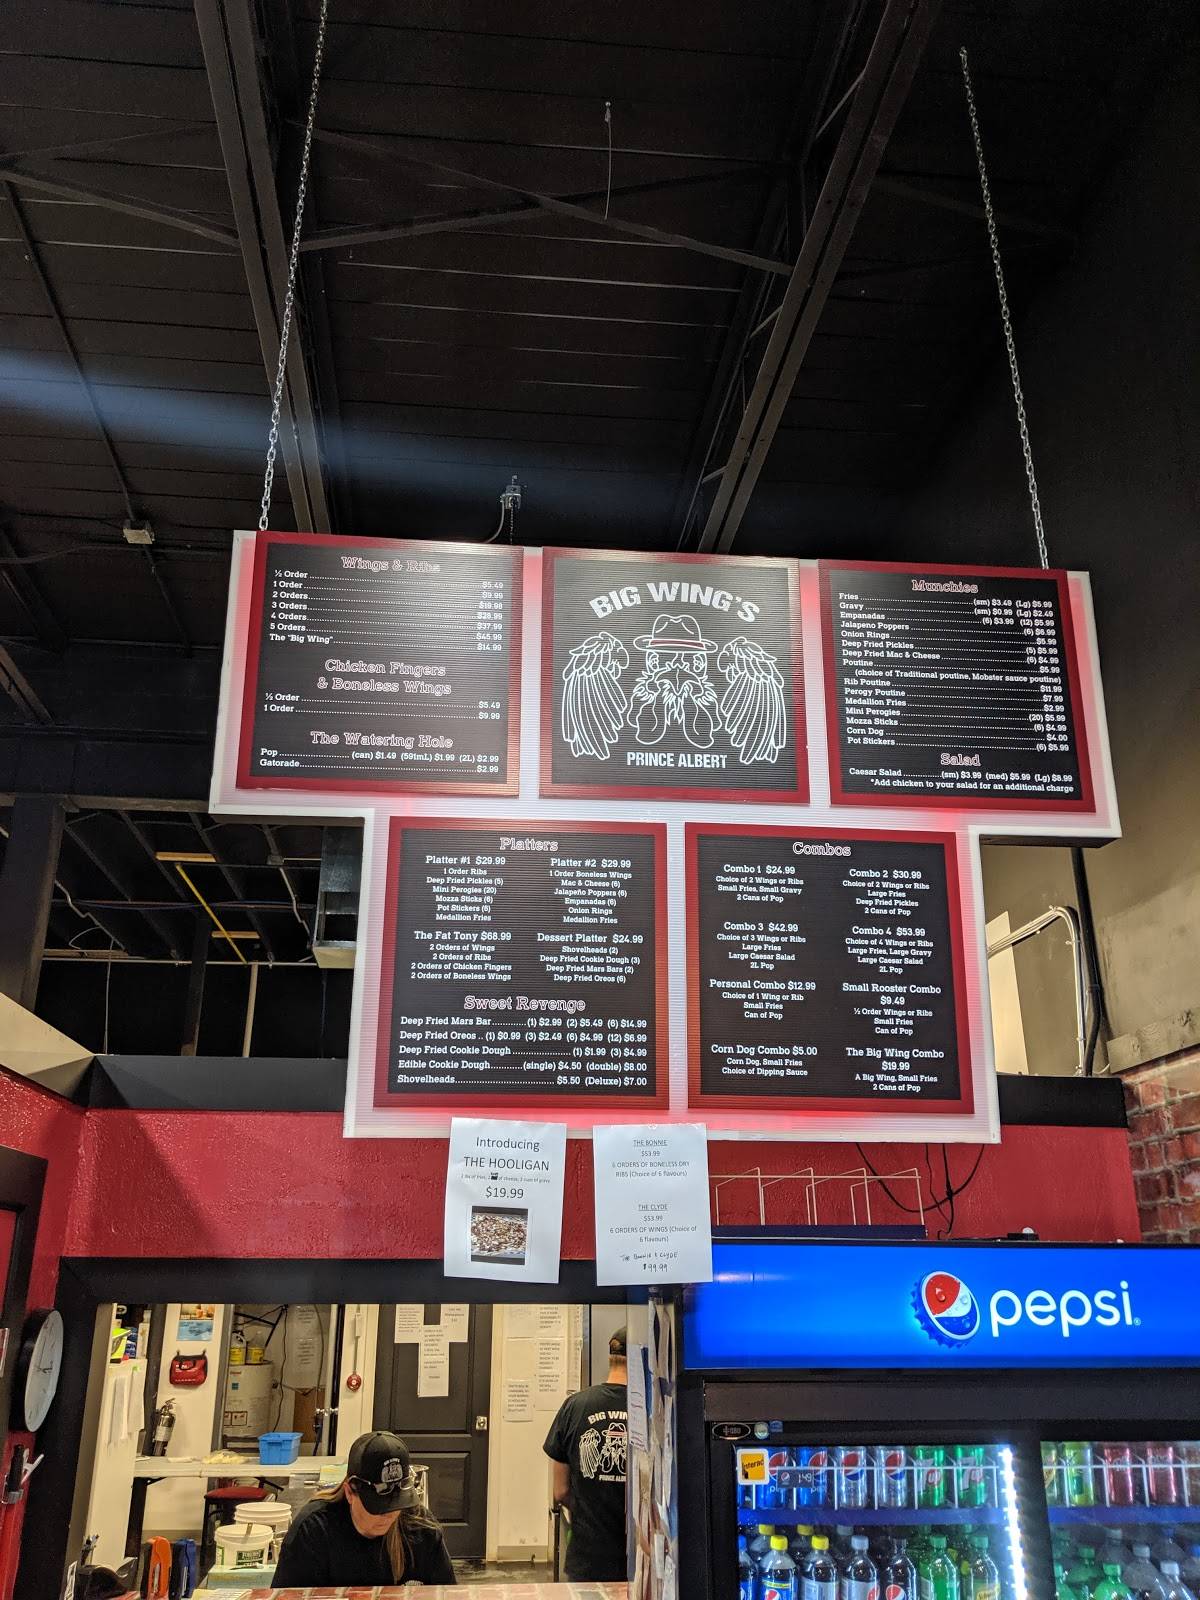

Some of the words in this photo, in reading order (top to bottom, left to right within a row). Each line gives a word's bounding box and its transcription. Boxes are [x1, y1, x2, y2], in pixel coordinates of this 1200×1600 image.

[341, 556, 388, 572] Wings
[392, 559, 403, 571] &
[406, 561, 440, 572] Ribs
[912, 580, 978, 593] Munchies
[589, 586, 641, 618] BIG
[646, 582, 760, 622] WING'S
[839, 592, 859, 600] Fries
[973, 598, 990, 607] (sm)
[1015, 599, 1031, 608] (Lg)
[269, 633, 286, 641] The
[287, 634, 305, 643] "Big
[307, 635, 333, 644] Wing"
[325, 659, 386, 674] Chicken
[389, 662, 446, 677] Fingers
[317, 678, 328, 689] &
[332, 677, 400, 692] Boneless
[403, 680, 452, 696] Wings
[860, 679, 891, 687] Poutine
[275, 693, 300, 702] Order
[478, 701, 501, 709] $5.49
[270, 704, 294, 712] Order
[478, 712, 501, 720] $9.99
[846, 717, 872, 726] Mozza
[874, 718, 898, 726] Sticks
[1033, 723, 1044, 732] (6)
[847, 727, 866, 735] Corn
[868, 727, 884, 736] Dog
[310, 731, 340, 745] The
[343, 732, 414, 748] Watering
[418, 735, 453, 747] Hole
[261, 748, 278, 758] Pop
[351, 751, 373, 761] (can)
[375, 751, 397, 760] $1.49
[400, 752, 433, 762] (591mL)
[434, 753, 455, 761] $1.99
[459, 753, 475, 763] (2L)
[477, 754, 499, 763] $2.99
[627, 752, 674, 767] PRINCE
[677, 753, 728, 769] ALBERT
[940, 753, 981, 766] Salad
[259, 759, 300, 768] Gatorade
[476, 765, 499, 773] $2.99
[892, 778, 923, 787] chicken
[935, 781, 954, 789] your
[956, 780, 977, 789] salad
[979, 781, 991, 789] for
[1005, 782, 1044, 791] additional
[1046, 784, 1074, 793] charge
[499, 837, 559, 851] Platters
[792, 842, 851, 856] Combos
[425, 855, 458, 865] Platter
[460, 856, 471, 864] #1
[475, 856, 506, 865] $29.99
[550, 858, 582, 868] Platter
[584, 859, 596, 867] #2
[601, 859, 631, 868] $29.99
[723, 864, 755, 873] Combo
[757, 865, 761, 873] 1
[766, 865, 796, 874] $24.99
[849, 869, 881, 878] Combo
[883, 870, 888, 878] 2
[892, 870, 922, 879] $30.99
[724, 922, 756, 931] Combo
[758, 923, 764, 931] 3
[768, 923, 798, 932] $42.99
[852, 926, 884, 935] Combo
[886, 927, 892, 935] 4
[414, 931, 433, 940] The
[435, 931, 451, 940] Fat
[453, 931, 478, 942] Tony
[537, 933, 573, 943] Dessert
[575, 934, 607, 943] Platter
[612, 934, 643, 943] $24.99
[710, 979, 751, 989] Personal
[753, 980, 785, 989] Combo
[787, 981, 816, 990] $12.99
[842, 983, 869, 992] Small
[872, 983, 908, 993] Rooster
[910, 984, 941, 994] Combo
[464, 995, 512, 1010] Sweet
[516, 996, 586, 1014] Revenge
[880, 996, 905, 1005] $9.49
[711, 1044, 734, 1054] Corn
[736, 1045, 755, 1055] Dog
[757, 1046, 790, 1055] Combo
[792, 1046, 817, 1055] $5.00
[846, 1047, 864, 1056] The
[866, 1048, 882, 1058] Big
[884, 1048, 910, 1059] Wing
[912, 1049, 944, 1058] Combo
[398, 1060, 427, 1069] Edible
[429, 1060, 459, 1069] Cookie
[461, 1061, 490, 1071] Dough
[523, 1062, 556, 1072] (single)
[557, 1062, 582, 1071] $4.50
[586, 1062, 622, 1072] (double)
[881, 1061, 910, 1070] $19.99
[397, 1075, 455, 1084] Shovelheads
[557, 1076, 581, 1085] $5.50
[584, 1076, 622, 1086] (Deluxe)
[623, 1077, 647, 1086] $7.00
[862, 1074, 874, 1082] Big
[876, 1075, 896, 1083] Wing,
[898, 1074, 918, 1082] Small
[476, 1136, 540, 1152] Introducing
[464, 1156, 485, 1168] THE
[489, 1158, 550, 1171] HOOLIGAN
[485, 1186, 524, 1199] $19.99
[989, 1280, 1135, 1337] pepsi
[588, 1411, 606, 1424] BIG
